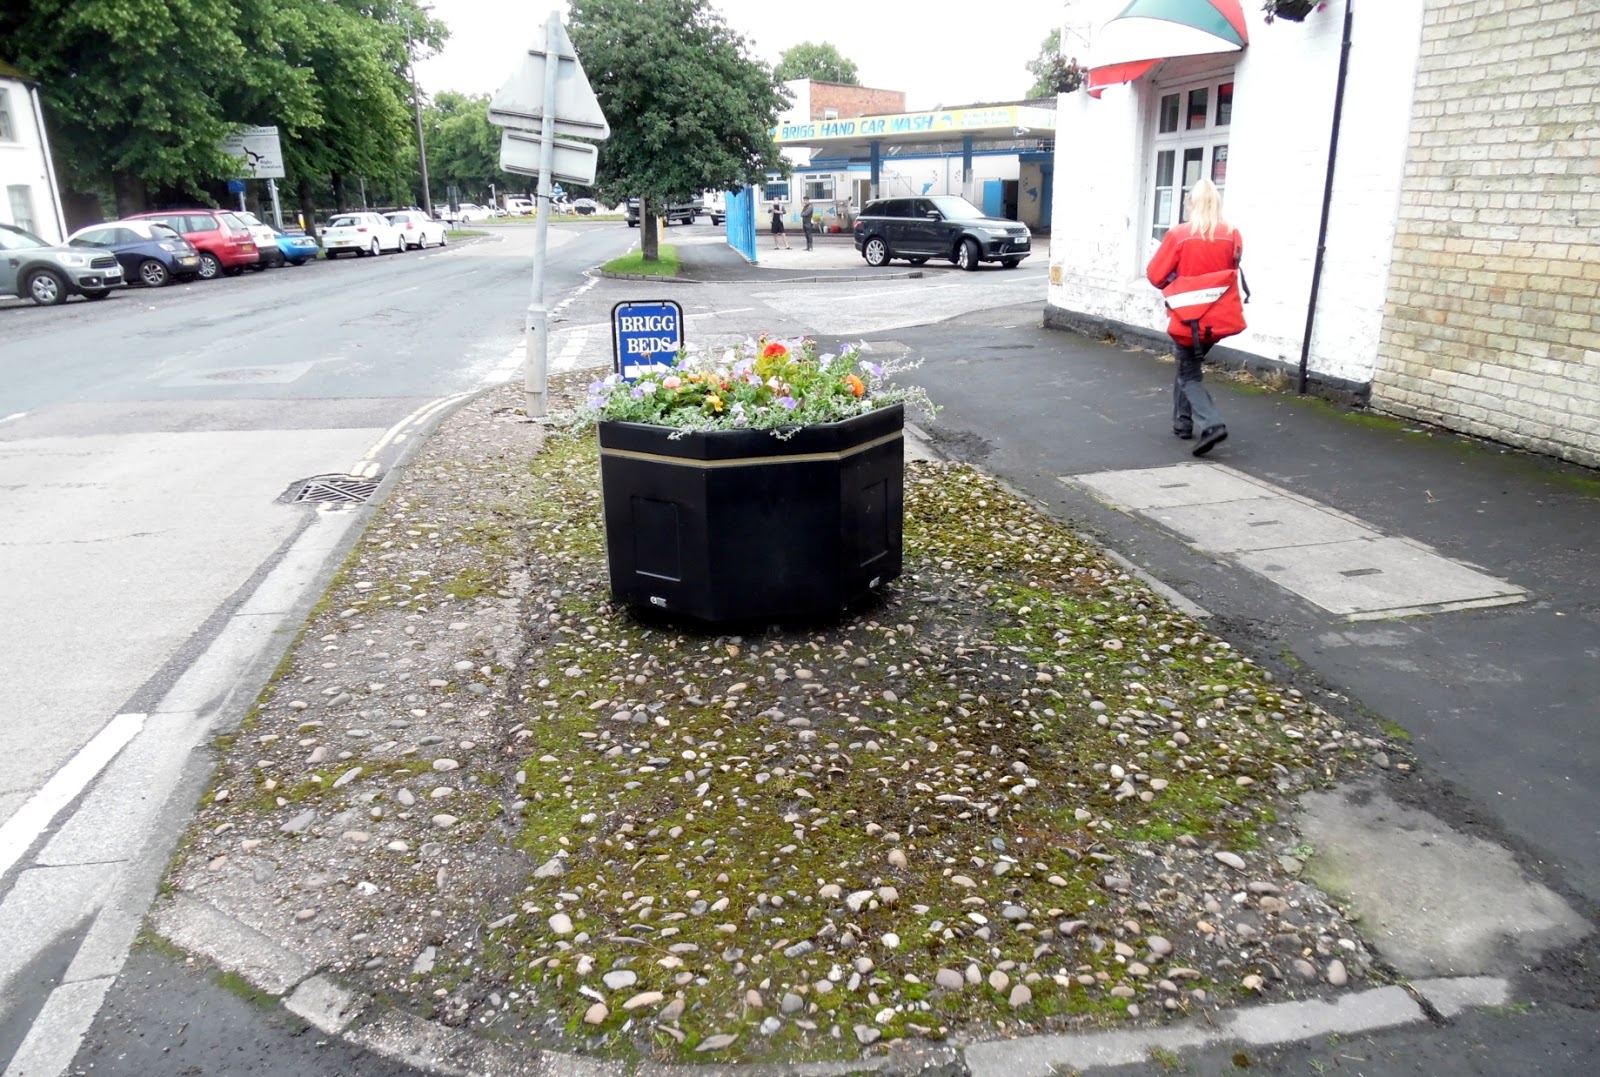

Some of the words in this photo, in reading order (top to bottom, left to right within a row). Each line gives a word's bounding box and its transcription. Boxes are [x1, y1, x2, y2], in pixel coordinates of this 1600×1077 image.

[781, 125, 815, 139] BRIGG
[820, 121, 855, 136] HAND
[860, 119, 886, 134] CAR
[890, 115, 934, 131] WASH
[621, 315, 675, 332] BRIGG
[627, 336, 671, 354] BEDS
